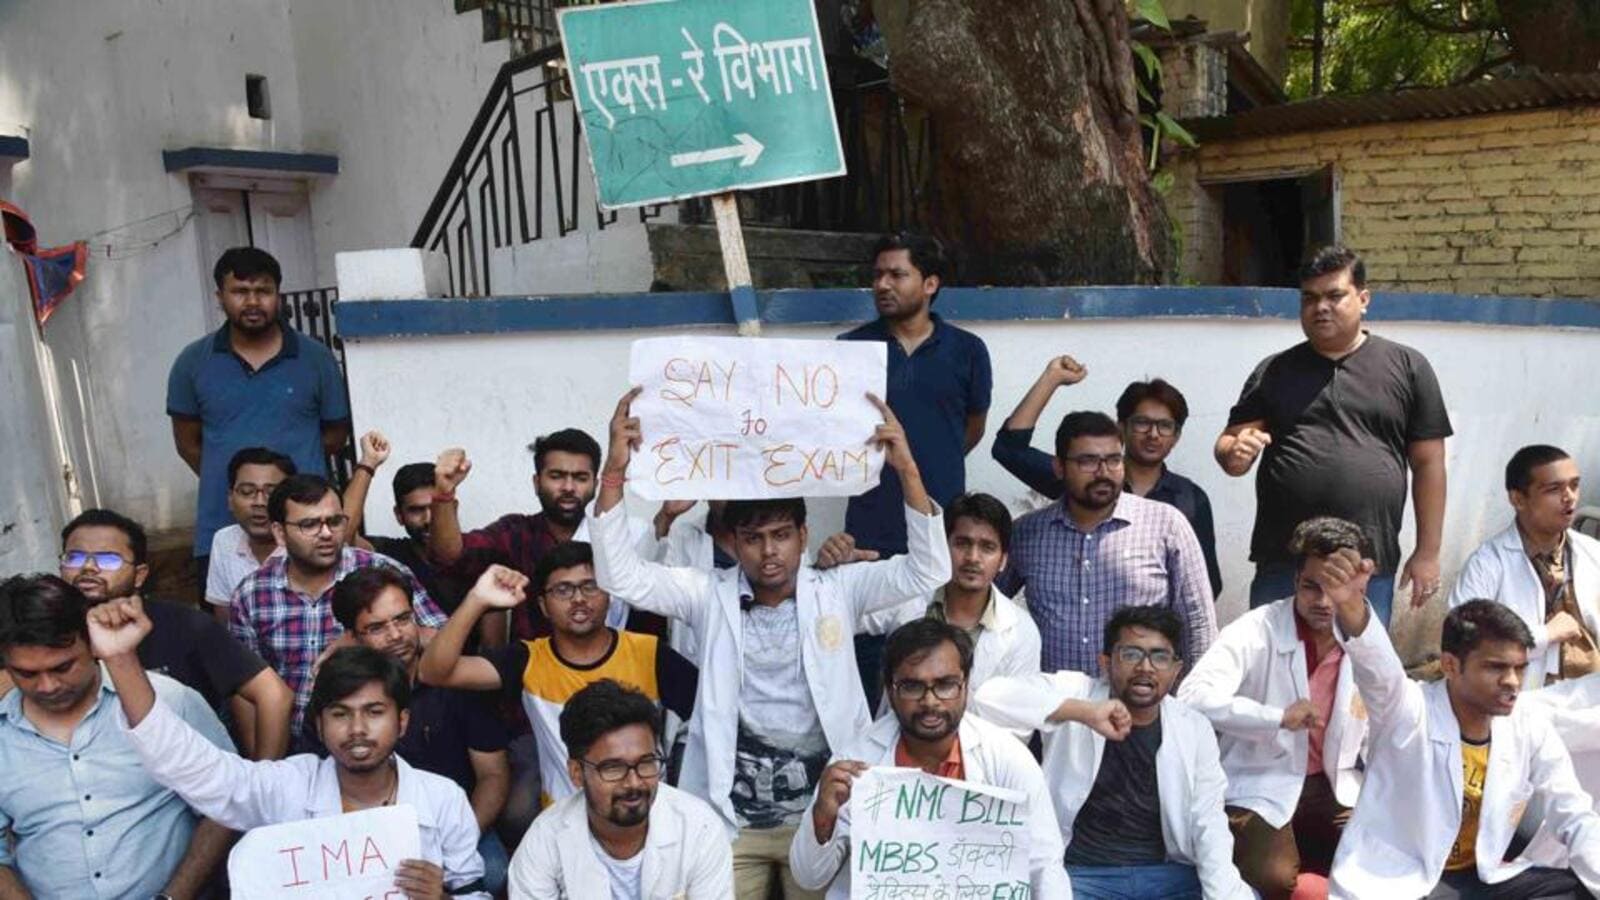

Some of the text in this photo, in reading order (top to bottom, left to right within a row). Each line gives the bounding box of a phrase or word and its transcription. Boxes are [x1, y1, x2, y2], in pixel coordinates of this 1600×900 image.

[713, 22, 818, 103] विभाग
[660, 358, 839, 408] SAY NO
[651, 436, 869, 487] EXIT EXAM
[957, 789, 1024, 826] BILL
[279, 835, 388, 888] IMA
[859, 830, 1020, 875] MBBS डॉक्टरी
